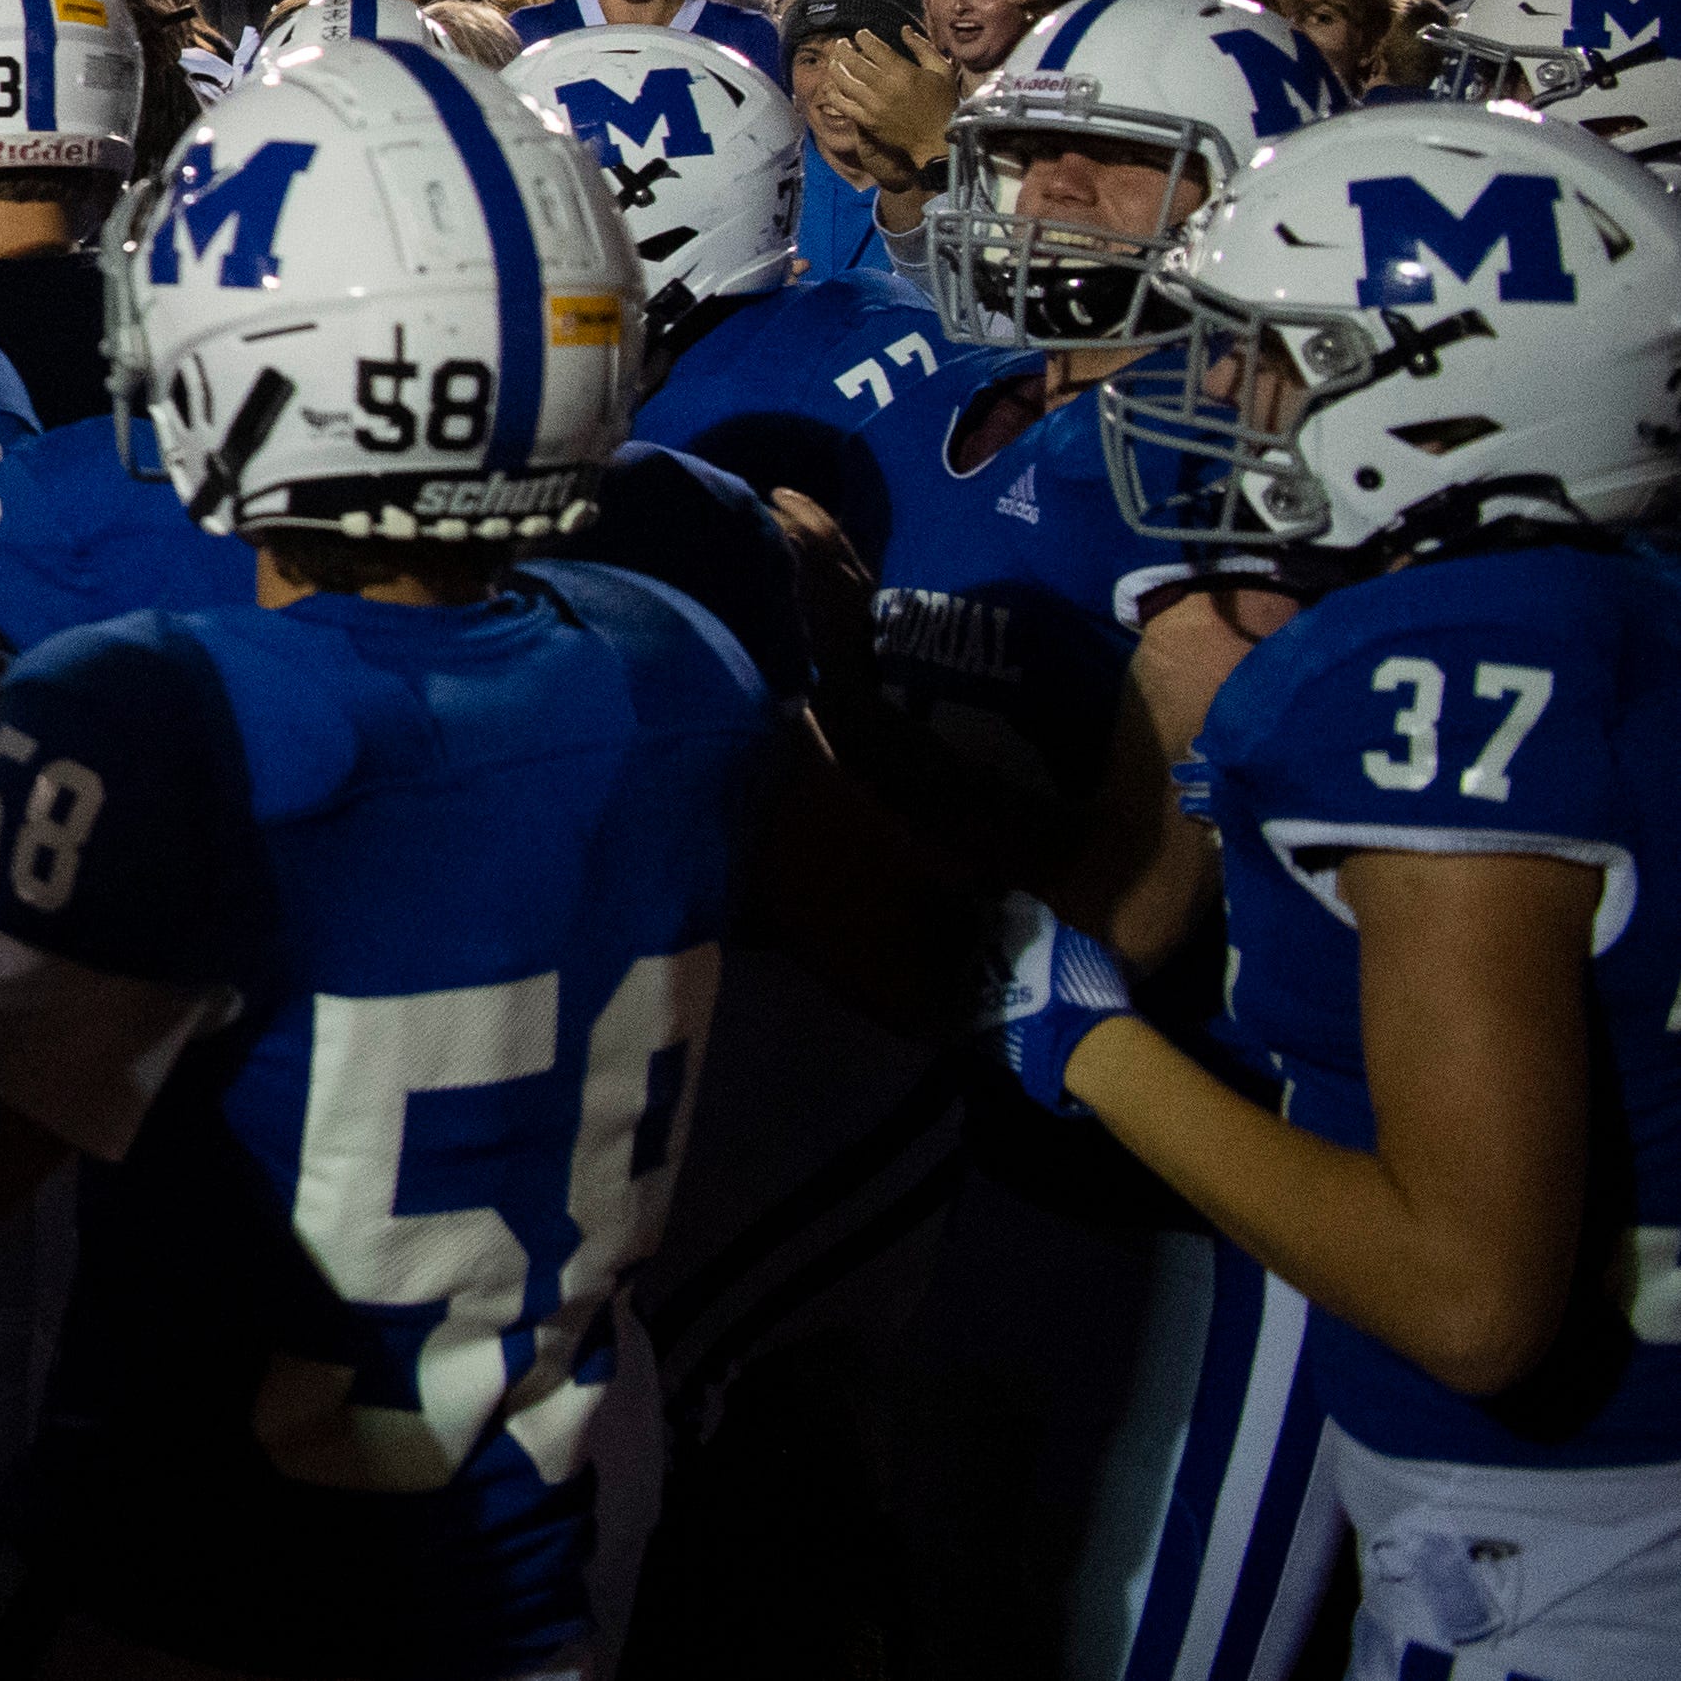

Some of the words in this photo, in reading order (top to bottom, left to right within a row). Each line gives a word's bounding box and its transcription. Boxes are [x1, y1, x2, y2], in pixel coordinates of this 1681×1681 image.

[555, 67, 714, 167] M
[149, 142, 319, 288] M
[1349, 174, 1577, 310] M
[354, 356, 493, 453] 58
[1361, 655, 1555, 805] 37
